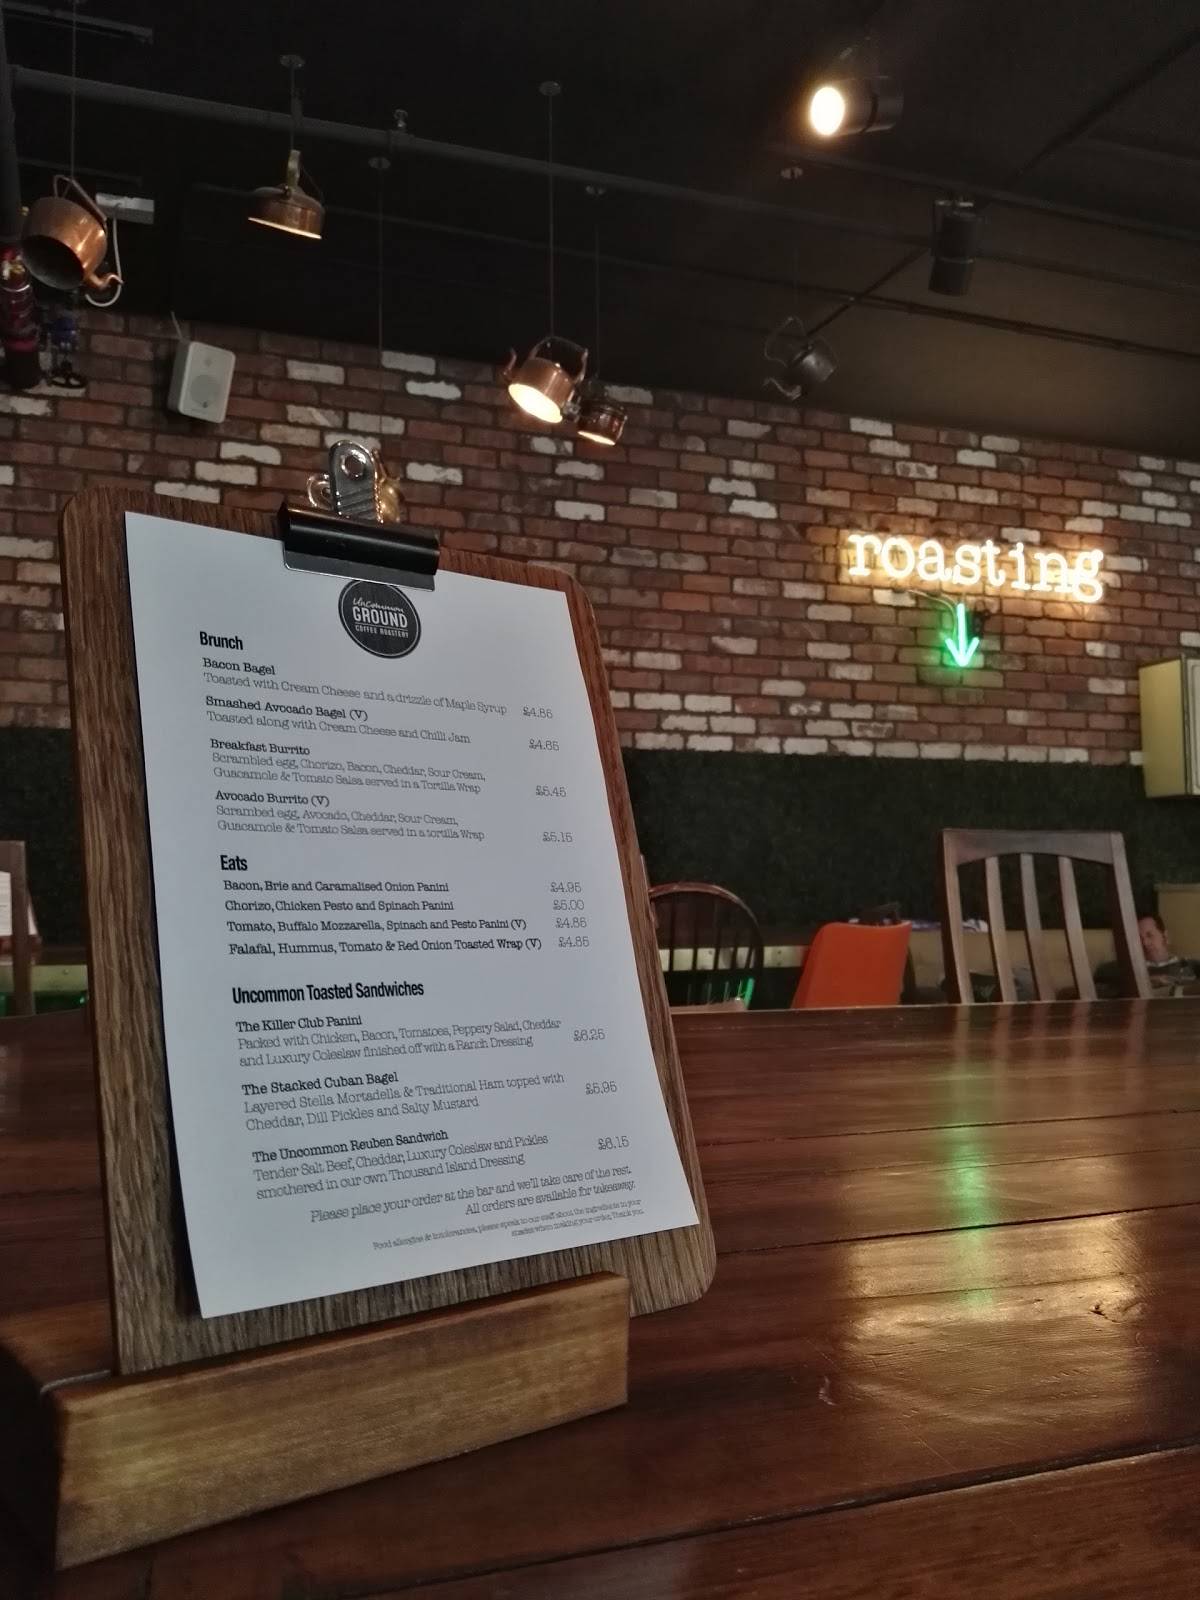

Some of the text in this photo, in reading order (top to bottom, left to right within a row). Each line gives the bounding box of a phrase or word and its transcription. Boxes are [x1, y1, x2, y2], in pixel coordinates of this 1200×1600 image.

[848, 534, 1104, 602] roasting
[353, 606, 408, 628] GROUND
[355, 624, 378, 634] COFFEE
[200, 631, 243, 650] Brunch
[203, 658, 275, 676] Bacon Bagel
[204, 672, 507, 716] Toasted with Cream Cheese Maple Syrup
[206, 696, 368, 721] Smashed Avocado Bagel (V)
[207, 711, 471, 743] Toasted along with Cream Cheese Jam
[210, 738, 310, 755] Breakfast Burrito
[213, 752, 273, 766] Scrambled
[428, 767, 451, 777] Sour
[214, 767, 278, 780] Guacamole
[292, 772, 334, 784] Tomato
[457, 783, 481, 794] Wrap
[216, 790, 330, 807] Avocado Burrito (V)
[298, 823, 339, 834] Tomato
[460, 830, 484, 842] Wrap
[220, 855, 248, 871] Eats
[265, 881, 289, 890] Brie
[292, 881, 313, 891] and
[385, 882, 415, 891] Onion
[417, 882, 449, 892] Panini
[276, 901, 322, 911] Chicken
[324, 901, 353, 910] Pesto
[356, 901, 376, 910] and
[378, 901, 420, 912] Spinach
[422, 901, 454, 910] Panini
[278, 921, 318, 931] Buffalo
[387, 920, 428, 932] Spinach
[430, 920, 448, 929] and
[451, 920, 477, 929] Pesto
[479, 920, 509, 928] Panini
[511, 919, 526, 930] (V)
[339, 942, 383, 952] Tomato
[386, 941, 395, 951] &
[398, 940, 419, 950] Red
[422, 940, 453, 950] Onion
[454, 939, 495, 949] Toasted
[497, 939, 523, 950] Wrap
[526, 938, 541, 950] (V)
[232, 981, 424, 1004] Uncommon Toasted Sandwiches
[236, 1015, 362, 1032] The Killer Club Panini
[238, 1036, 280, 1049] Packed
[284, 1035, 309, 1046] with
[452, 1025, 492, 1036] Peppery
[522, 1019, 561, 1030] Cheddar
[240, 1036, 533, 1067] and Luxury Coleslaw finished Ranch Dressing
[242, 1072, 399, 1095] The Stacked Cuban Bagel
[244, 1098, 296, 1114] Layered
[300, 1095, 335, 1108] Stella
[337, 1088, 401, 1104] Mortadella
[415, 1081, 477, 1096] Traditional
[479, 1080, 505, 1090] Ham
[507, 1075, 541, 1089] topped
[542, 1073, 564, 1084] with
[307, 1112, 328, 1124] Dill
[331, 1108, 374, 1122] Pickles
[377, 1104, 399, 1117] and
[402, 1103, 430, 1115] Salty
[433, 1096, 480, 1111] Mustard
[253, 1130, 448, 1162] The Uncommon Reuben Sandwich
[253, 1167, 299, 1181] Tender
[302, 1162, 323, 1175] Salt
[407, 1148, 447, 1161] Luxury
[449, 1142, 492, 1155] Coleslaw
[515, 1135, 548, 1147] Pickles
[257, 1153, 525, 1199] smothered our own Thousand Island Dressing
[311, 1173, 583, 1222] Please place your order and we'll care
[466, 1188, 577, 1215] All orders are available
